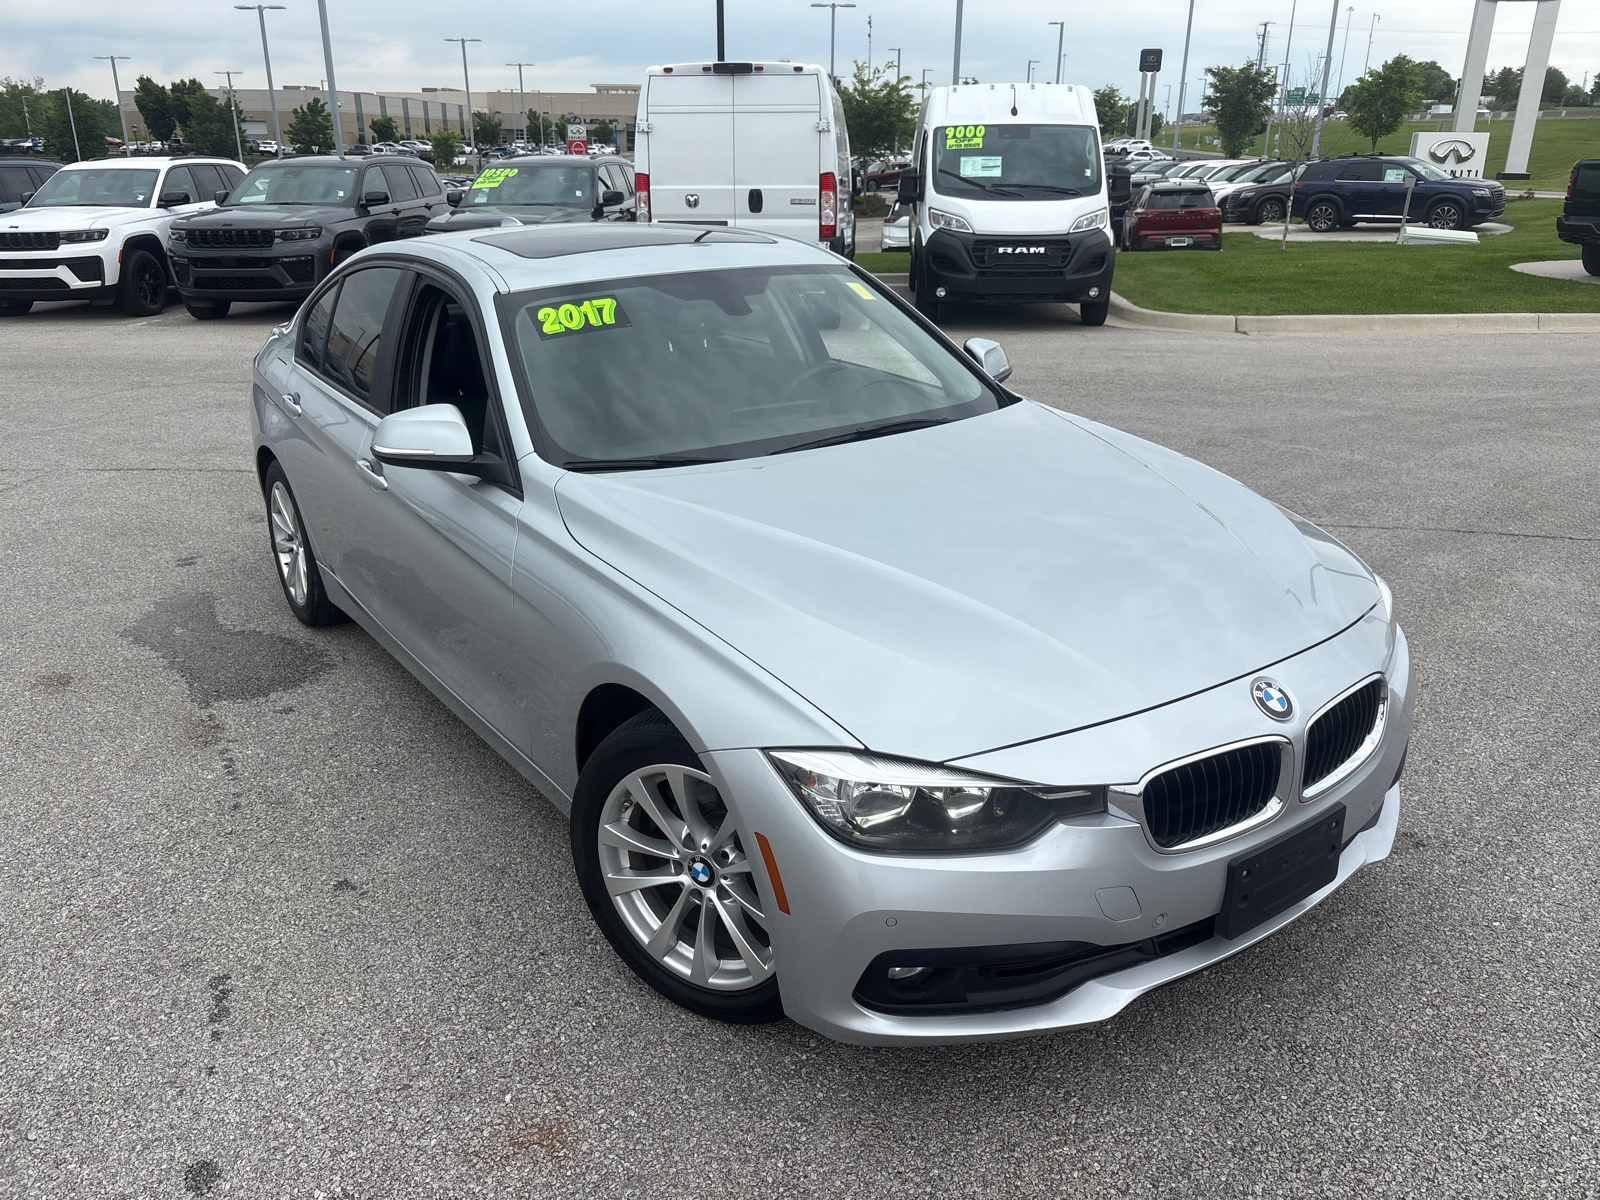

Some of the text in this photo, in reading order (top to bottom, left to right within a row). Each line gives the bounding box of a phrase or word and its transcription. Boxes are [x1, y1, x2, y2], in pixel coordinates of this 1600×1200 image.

[945, 125, 986, 139] 9000
[480, 168, 519, 178] 10500
[998, 246, 1046, 254] RAM
[537, 298, 617, 335] 2017
[1254, 681, 1281, 698] BMW
